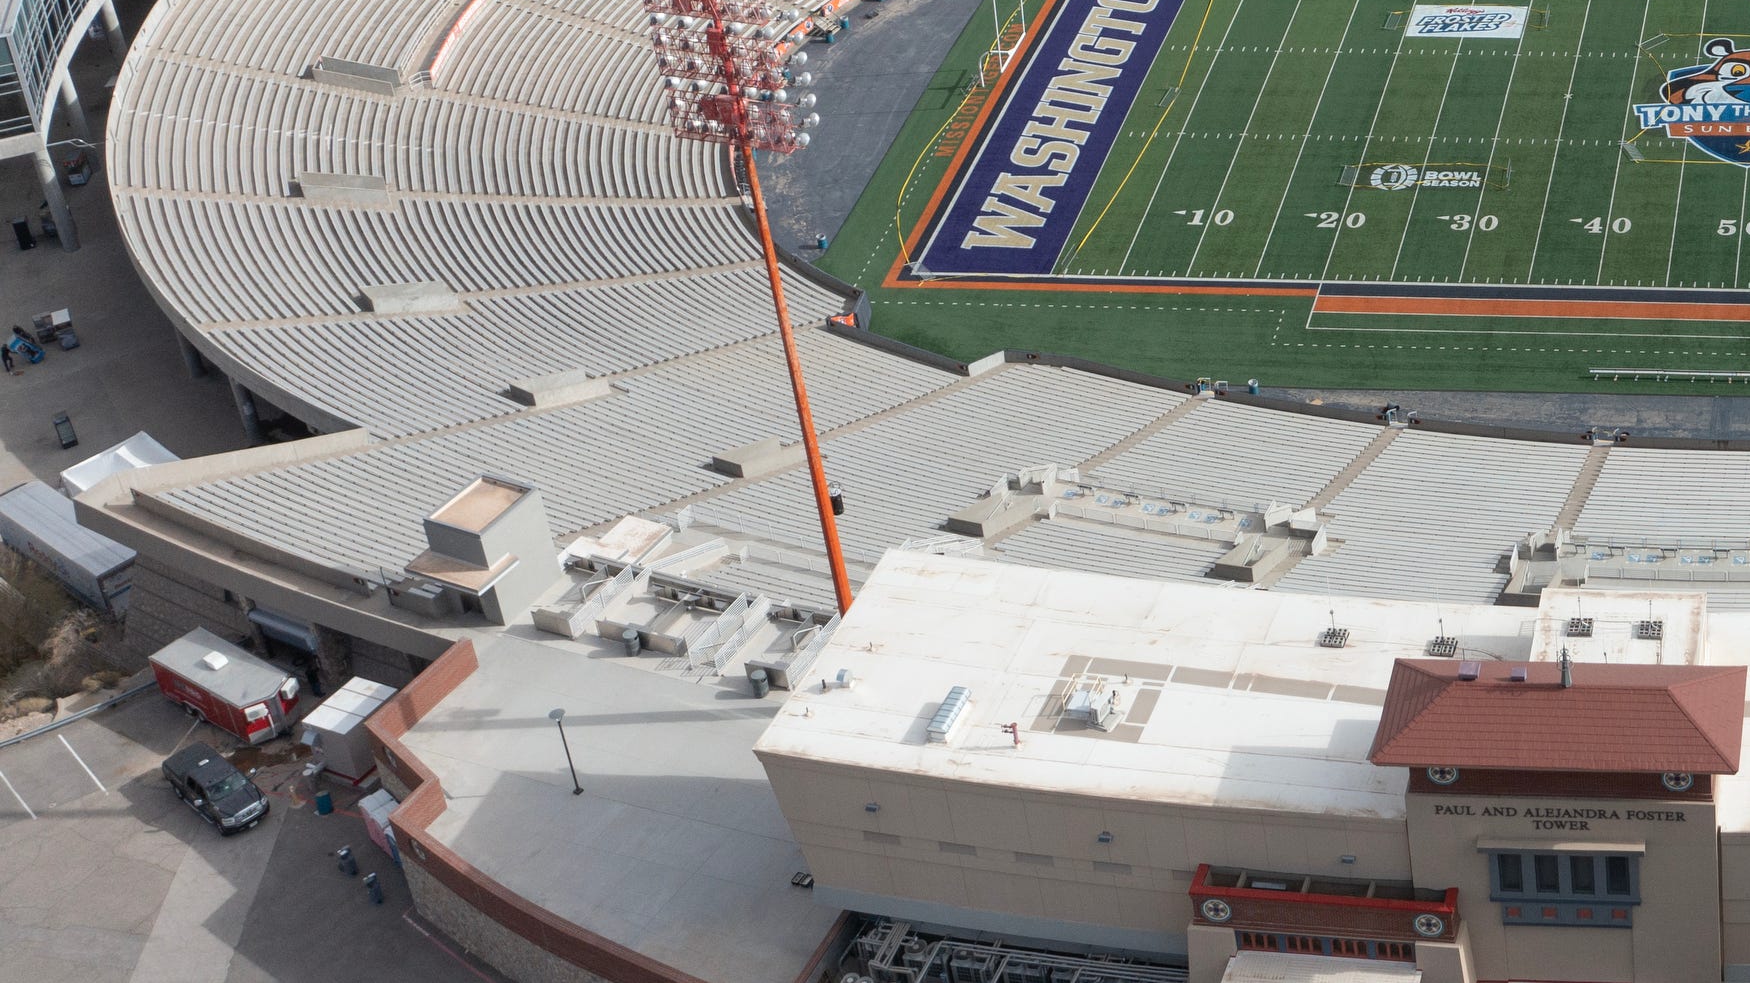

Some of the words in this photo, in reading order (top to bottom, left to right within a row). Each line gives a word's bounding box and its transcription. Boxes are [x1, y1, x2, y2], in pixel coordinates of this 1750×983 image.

[1417, 12, 1512, 27] FROSTED
[1419, 21, 1500, 34] FLAKES
[1641, 104, 1728, 126] TONY
[1683, 124, 1733, 134] SUN
[1421, 179, 1480, 188] SEASON
[1424, 171, 1482, 180] BOWL
[1186, 209, 1234, 227] 10
[1318, 212, 1367, 229] 20
[1450, 214, 1499, 232] 30
[1582, 217, 1632, 234] 40
[1434, 804, 1476, 816] PAUL
[1481, 806, 1518, 817] AND
[1523, 807, 1621, 821] ALEJANDRA
[1626, 809, 1687, 823] FOSTER
[1531, 819, 1591, 832] TOWER
